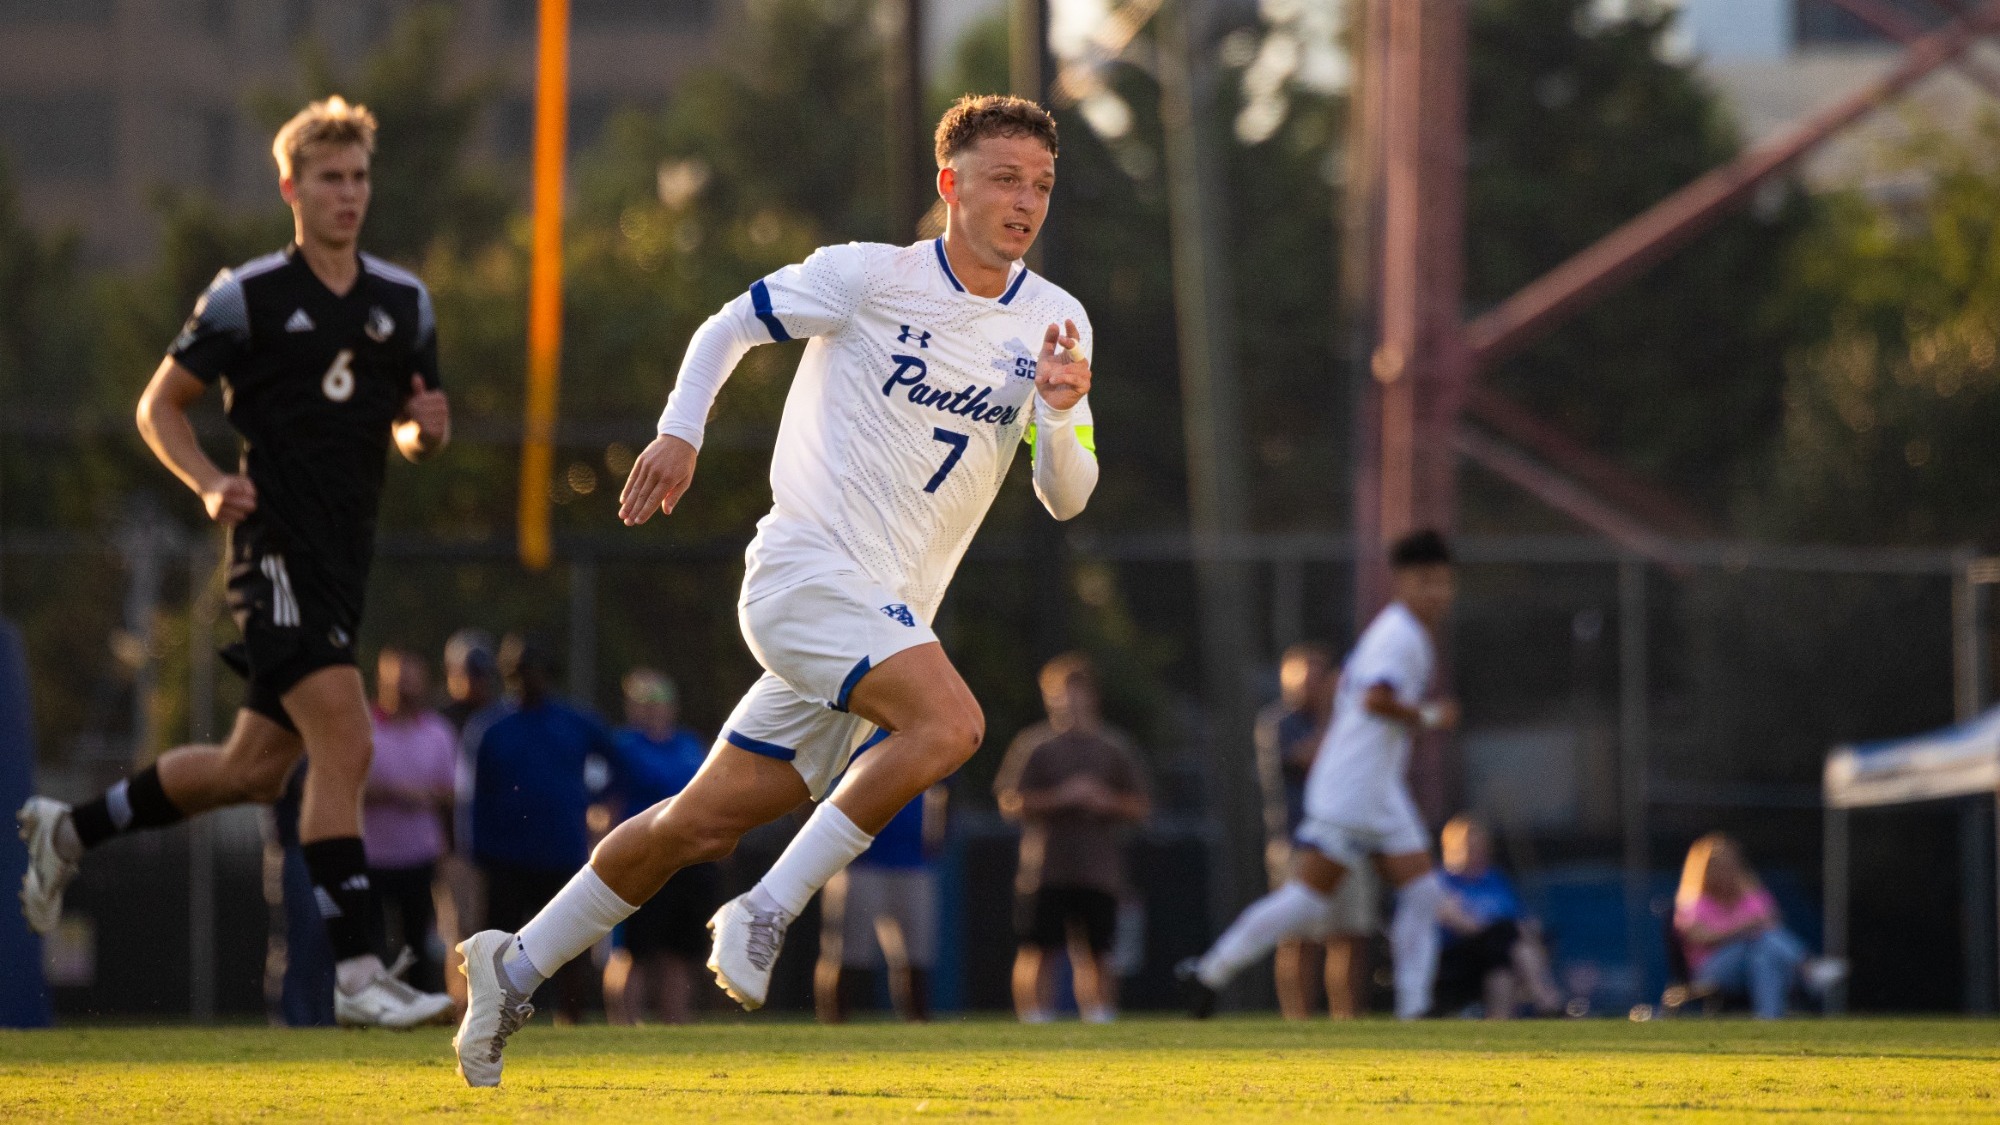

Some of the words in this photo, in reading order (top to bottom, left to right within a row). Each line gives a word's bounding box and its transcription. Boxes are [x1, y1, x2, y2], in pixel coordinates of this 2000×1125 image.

[321, 349, 355, 402] 6
[882, 354, 1020, 425] Panthers
[923, 427, 969, 494] 7
